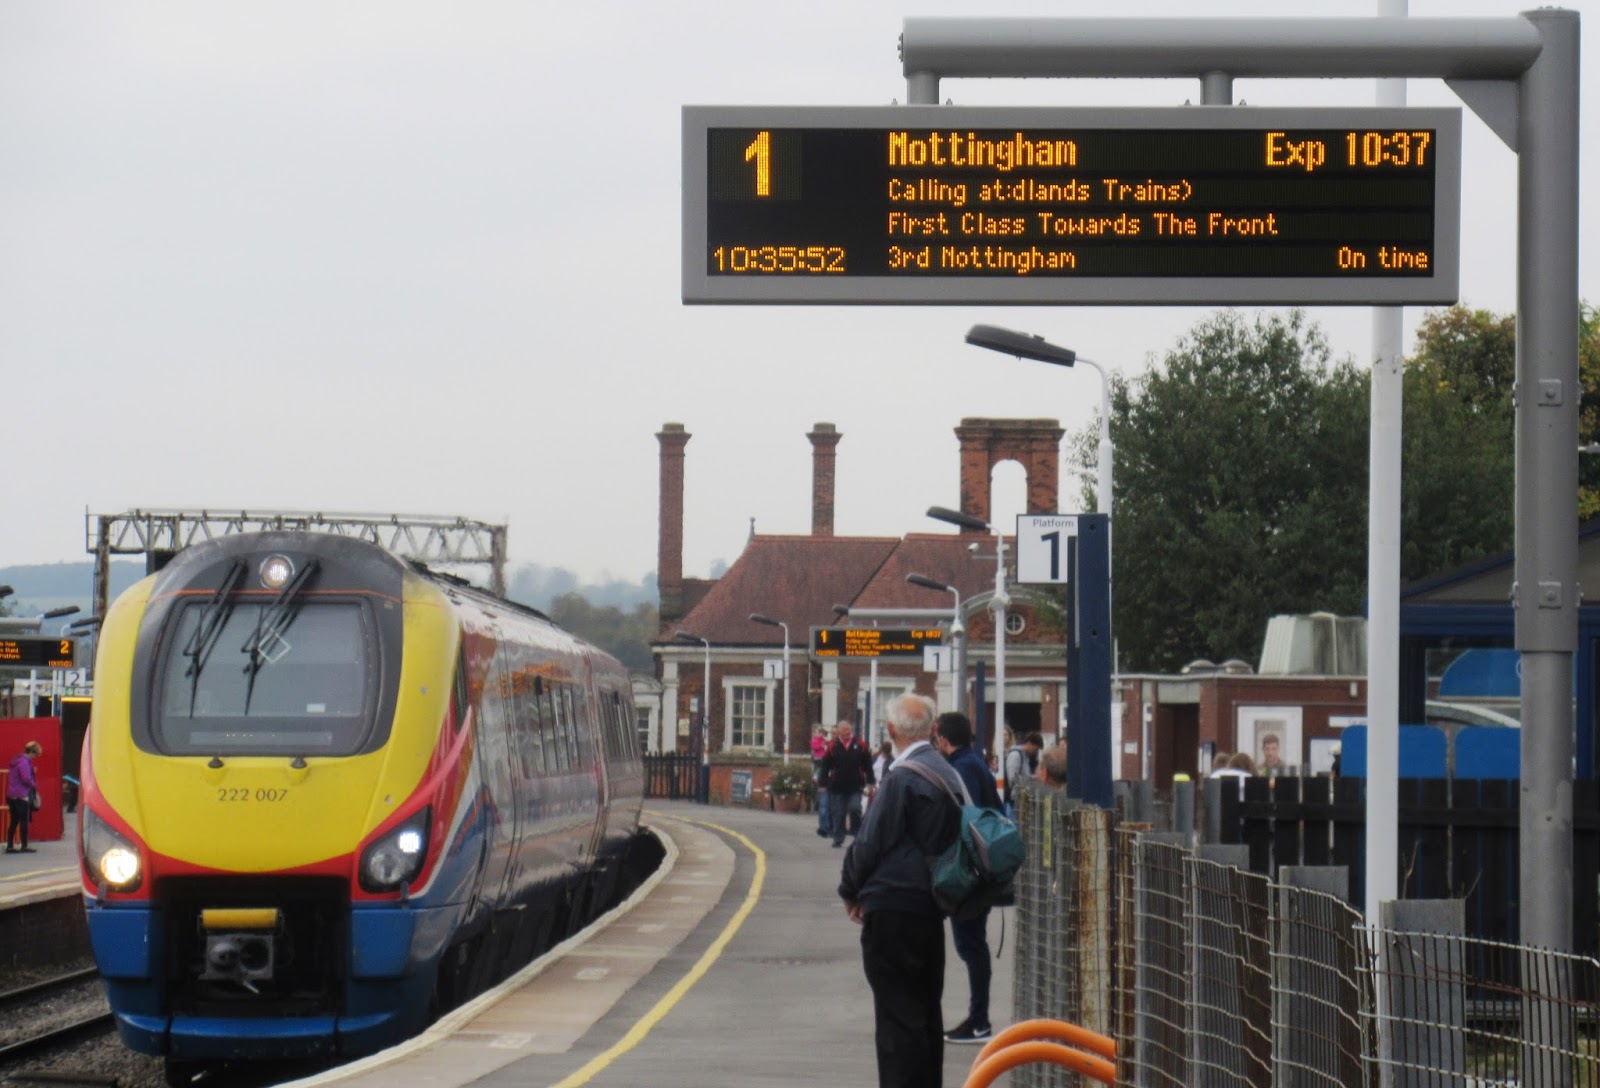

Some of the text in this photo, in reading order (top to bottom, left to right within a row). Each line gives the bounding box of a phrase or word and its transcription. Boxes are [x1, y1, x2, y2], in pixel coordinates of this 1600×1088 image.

[888, 131, 1077, 172] Nottingham
[1265, 131, 1430, 172] Exp 10:37
[744, 131, 770, 197] 1
[888, 178, 967, 207] Calling
[888, 212, 1279, 235] First Class Towards The Front
[713, 246, 845, 273] 10:35:52
[888, 245, 1076, 274] 3rd Nottingham
[1338, 246, 1428, 269] On time
[1032, 518, 1075, 528] Platform
[1040, 530, 1060, 580] 1
[60, 639, 70, 654] 2
[820, 630, 828, 643] 1
[932, 651, 940, 672] 1
[70, 671, 80, 687] 2
[217, 787, 288, 802] 222 007
